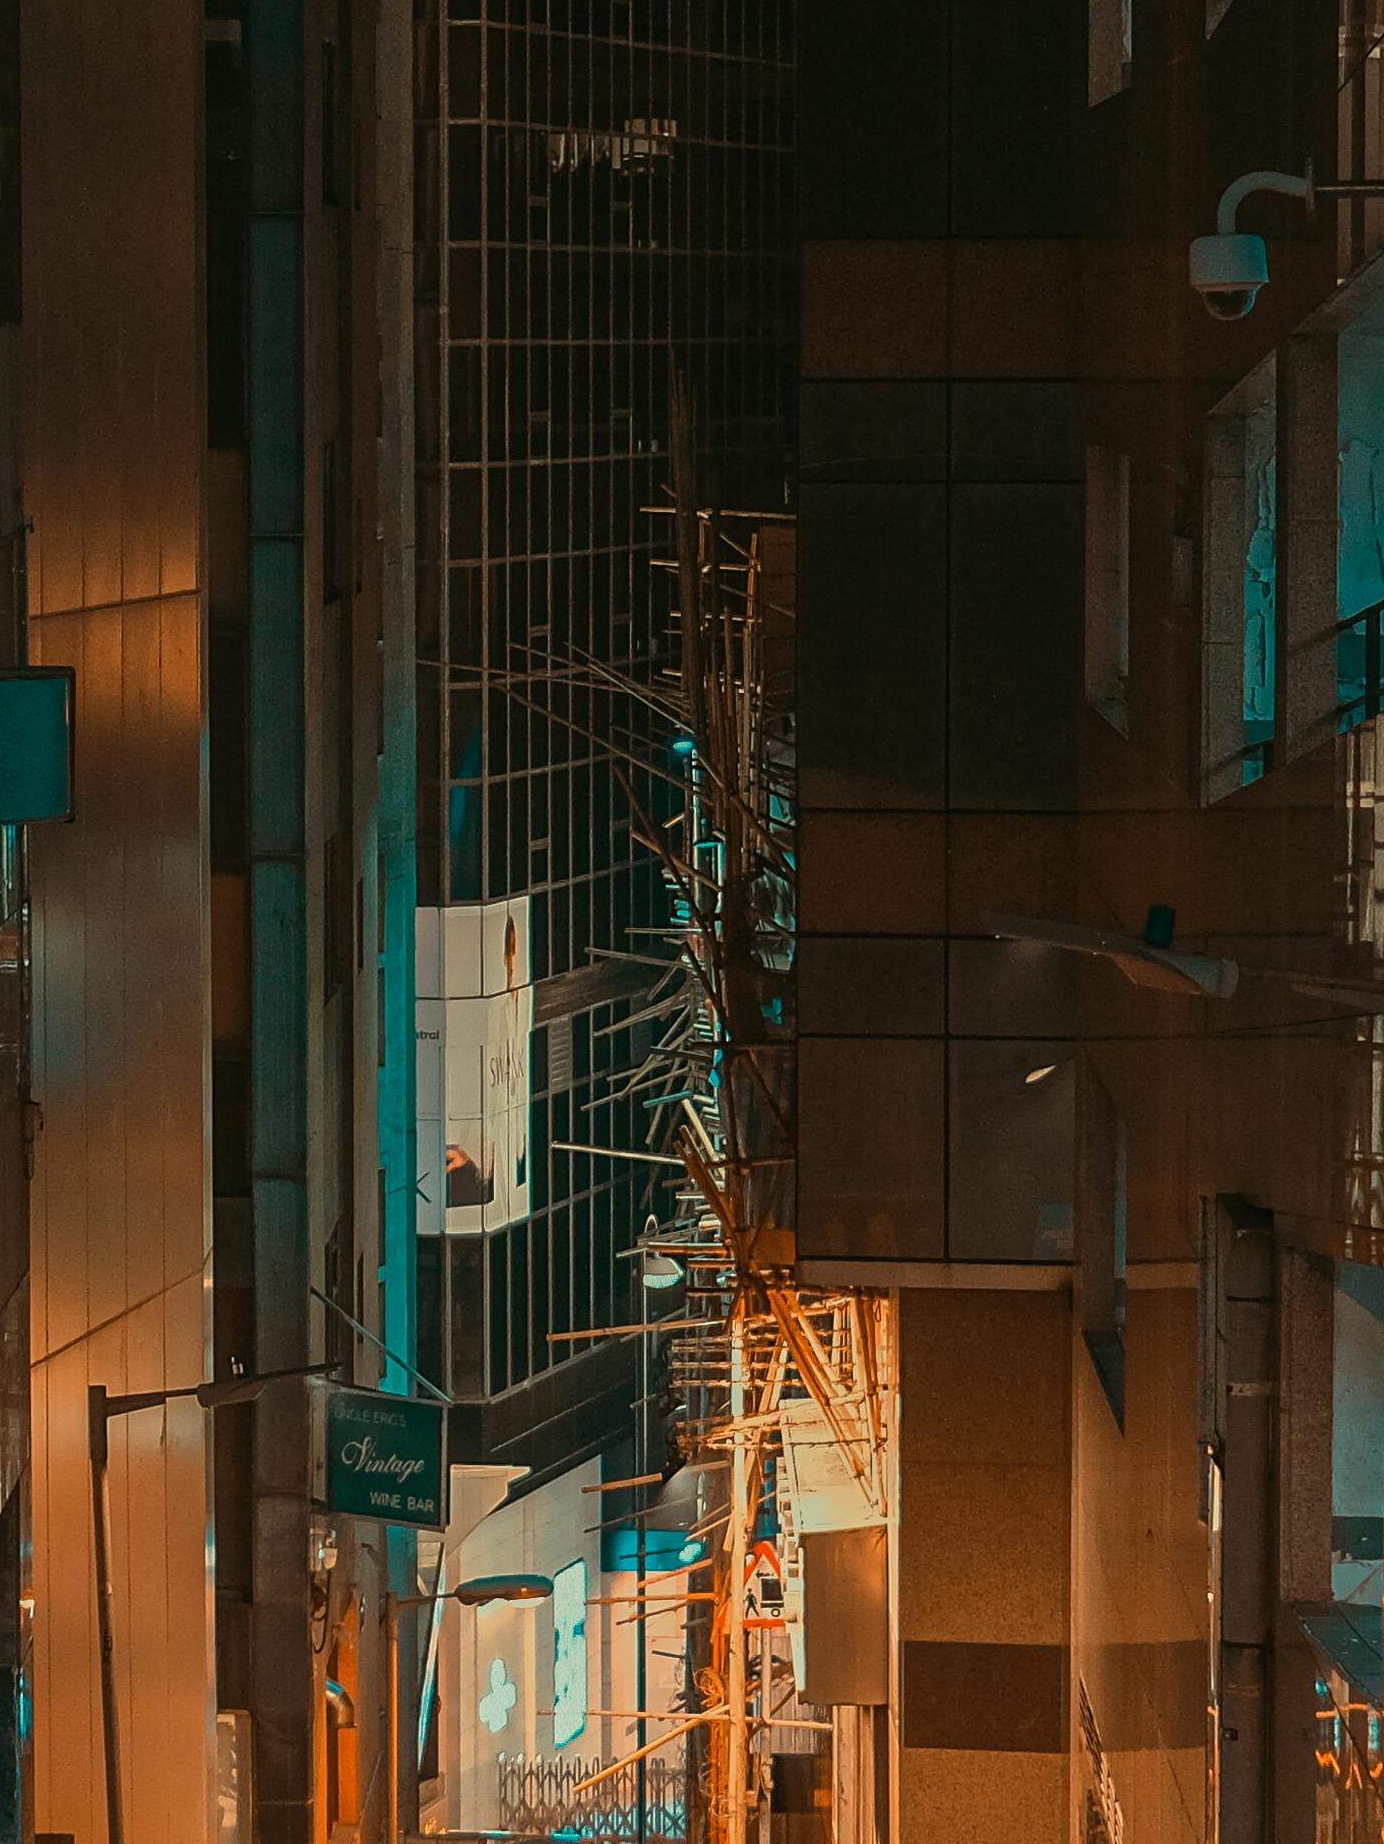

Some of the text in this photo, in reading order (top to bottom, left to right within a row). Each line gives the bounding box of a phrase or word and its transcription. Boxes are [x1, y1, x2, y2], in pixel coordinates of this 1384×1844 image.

[342, 1435, 425, 1483] Vintage
[369, 1491, 435, 1513] WINE BAR
